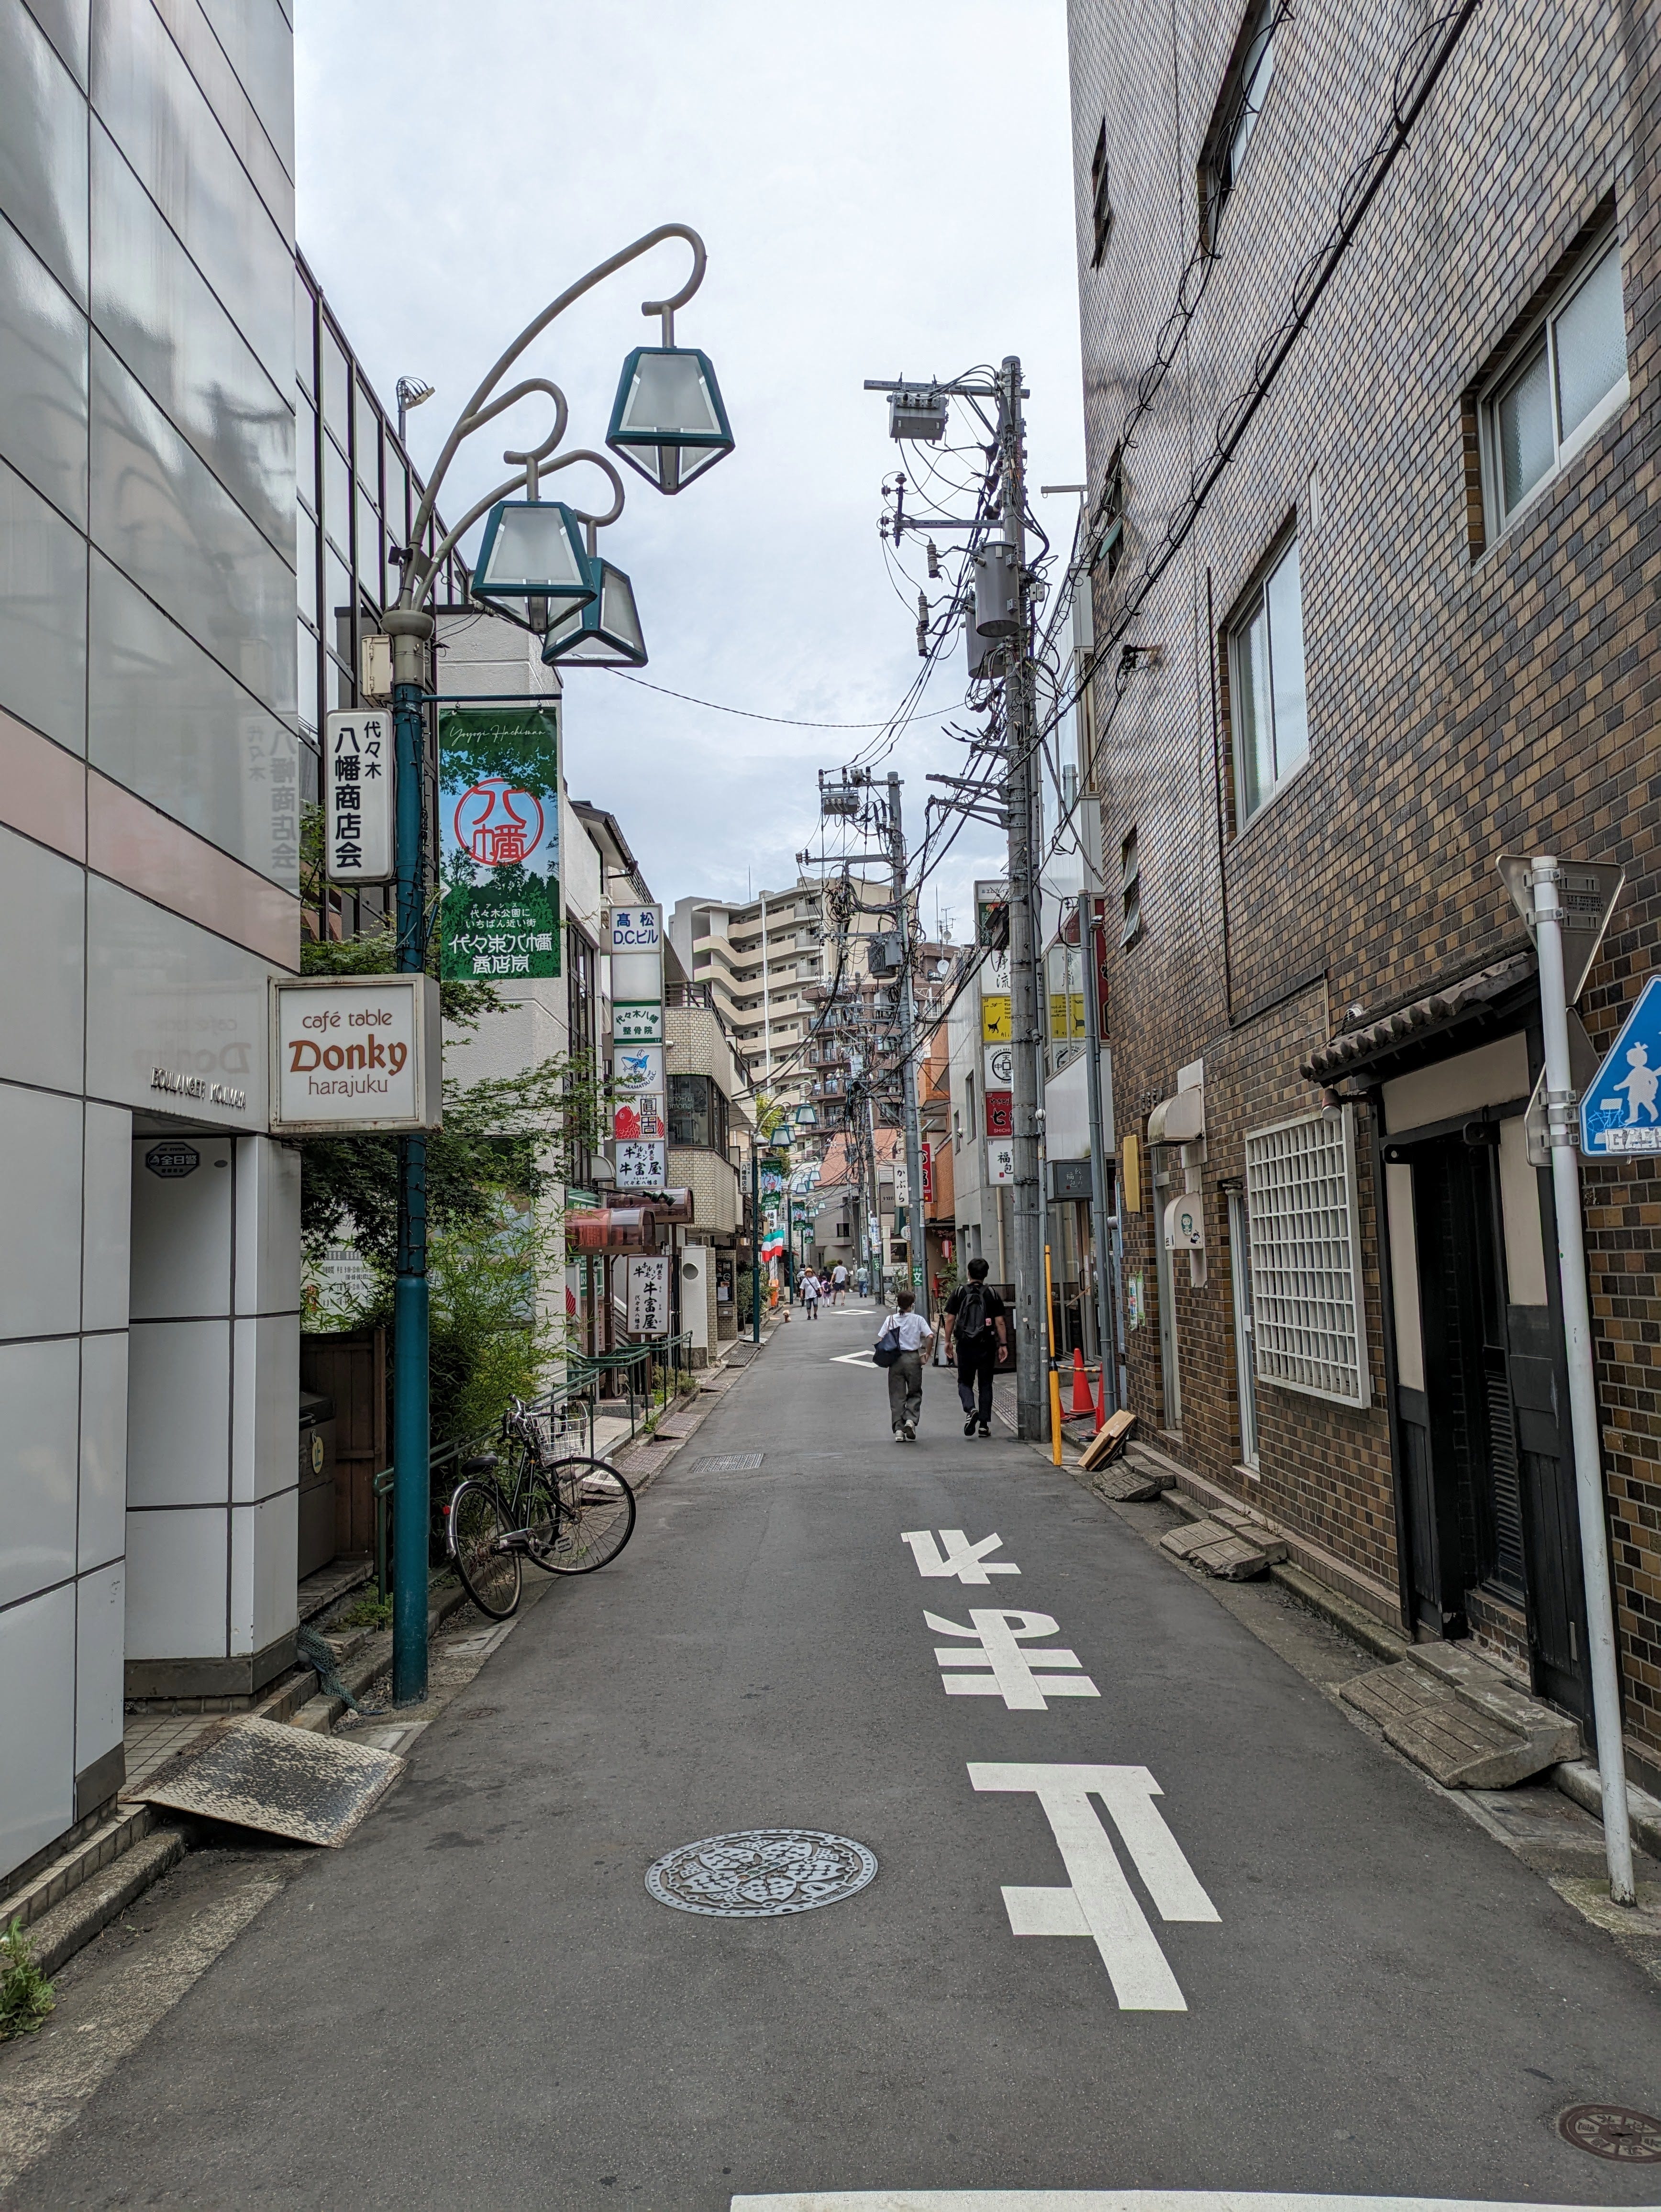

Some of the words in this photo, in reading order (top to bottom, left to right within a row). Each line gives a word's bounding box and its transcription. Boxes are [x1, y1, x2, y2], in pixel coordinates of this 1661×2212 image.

[450, 726, 489, 747] Yoyogi
[490, 725, 546, 743] Hachiman
[364, 721, 382, 779] 代々木
[335, 727, 362, 868] 八幡商店会
[465, 918, 536, 929] いちばん近い街
[470, 908, 531, 918] 代々木公園に
[613, 929, 658, 945] D.C.ビル
[302, 1011, 341, 1033] café
[348, 1008, 392, 1027] table
[616, 1009, 659, 1025] 代々木八幡
[623, 1026, 653, 1035] 整骨院
[289, 1034, 407, 1076] Donky
[151, 1067, 206, 1099] BOULANGER
[210, 1083, 246, 1109] KOJIMAYA
[309, 1074, 388, 1097] harajuku
[161, 1155, 197, 1165] 全日警
[620, 1161, 662, 1176] 牛富屋
[896, 1169, 906, 1203] かぶら
[913, 1272, 922, 1283] 文
[642, 1281, 658, 1329] 牛富屋
